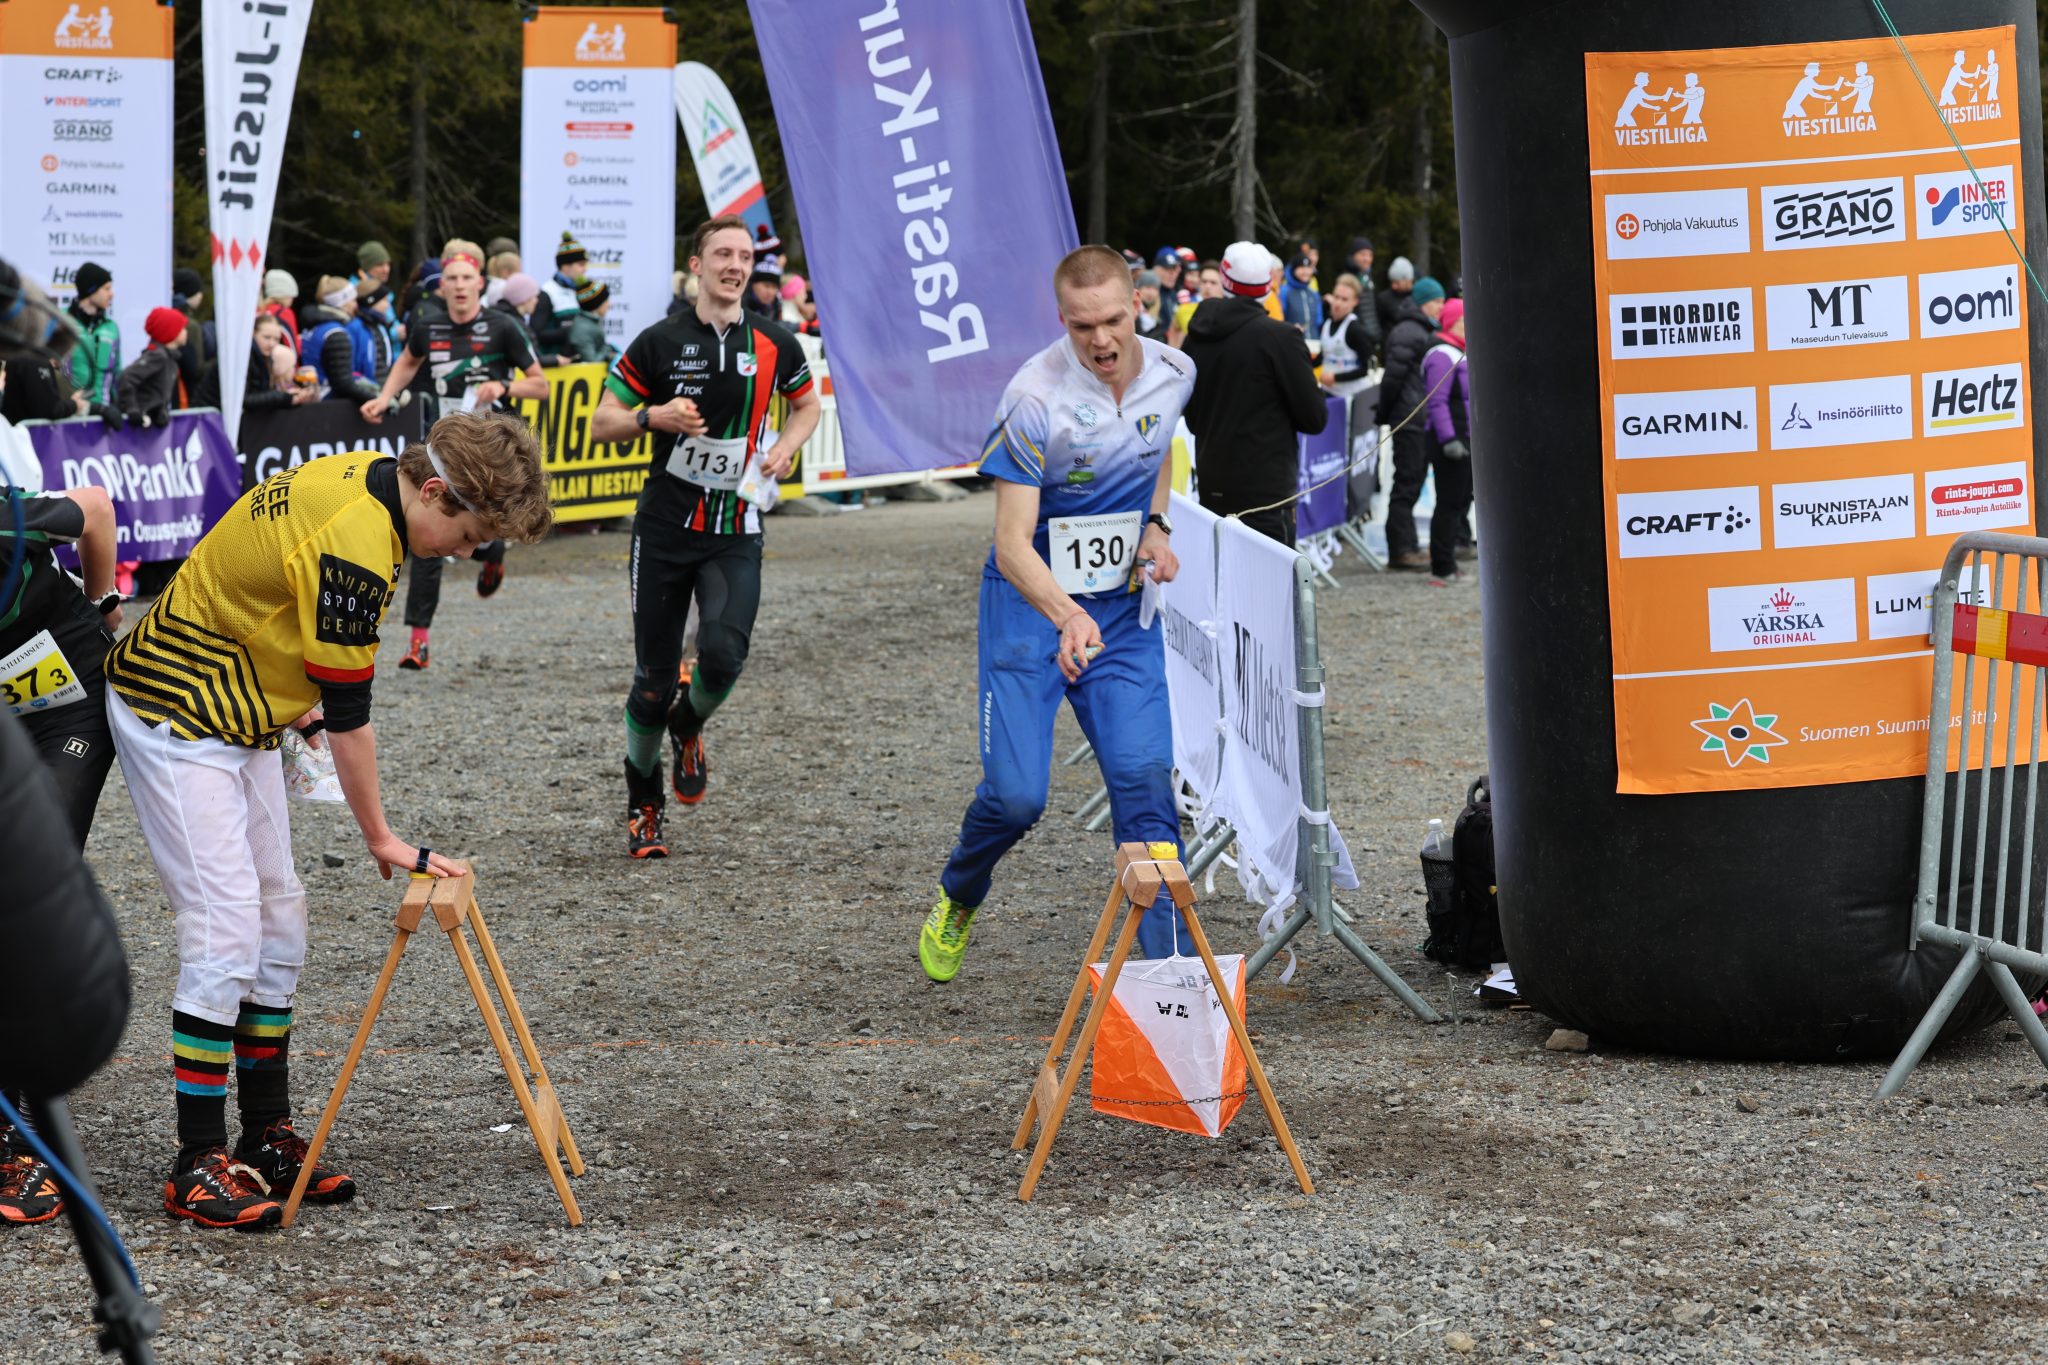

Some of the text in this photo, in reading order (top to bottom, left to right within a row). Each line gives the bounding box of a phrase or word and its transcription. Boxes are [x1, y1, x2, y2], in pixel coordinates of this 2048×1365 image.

[44, 67, 105, 81] CRAFT
[573, 75, 627, 92] oomi
[1939, 102, 2002, 124] VIESTILIIGA
[53, 123, 113, 137] GRANO
[1614, 126, 1708, 146] VIESTILIIGA
[1782, 114, 1877, 138] VIESTILIIGA
[46, 182, 116, 195] GARMIN
[1961, 180, 2006, 203] INTER
[1774, 197, 1894, 230] GRANO
[1962, 201, 2006, 223] SPORT
[1643, 216, 1739, 234] Pohjola Vakuutus
[583, 249, 623, 263] ertz
[1807, 283, 1873, 329] MT
[1928, 276, 2014, 325] oomi
[1659, 300, 1740, 326] NORDIC
[1659, 324, 1742, 345] TEAMWEAR
[1791, 330, 1889, 345] Maaseudun Tulevaisuus
[683, 386, 703, 395] TOK
[1932, 373, 2018, 418] Hertz
[1622, 410, 1743, 436] GARMIN
[1818, 405, 1903, 422] Insinööriliitto
[1945, 483, 2014, 499] rinta-jouppi.com
[1780, 495, 1909, 517] SUUNNISTAJAN
[1936, 501, 2022, 518] Rinta-Joupin Autoliike
[1626, 511, 1722, 536] CRAFT
[1811, 510, 1883, 528] KAUPPA
[1066, 535, 1124, 570] 130
[1742, 612, 1825, 633] VÄRSKA
[1753, 632, 1817, 646] ORIGINAAL
[984, 691, 993, 755] TRIMTEX
[1800, 721, 1870, 742] Suomen
